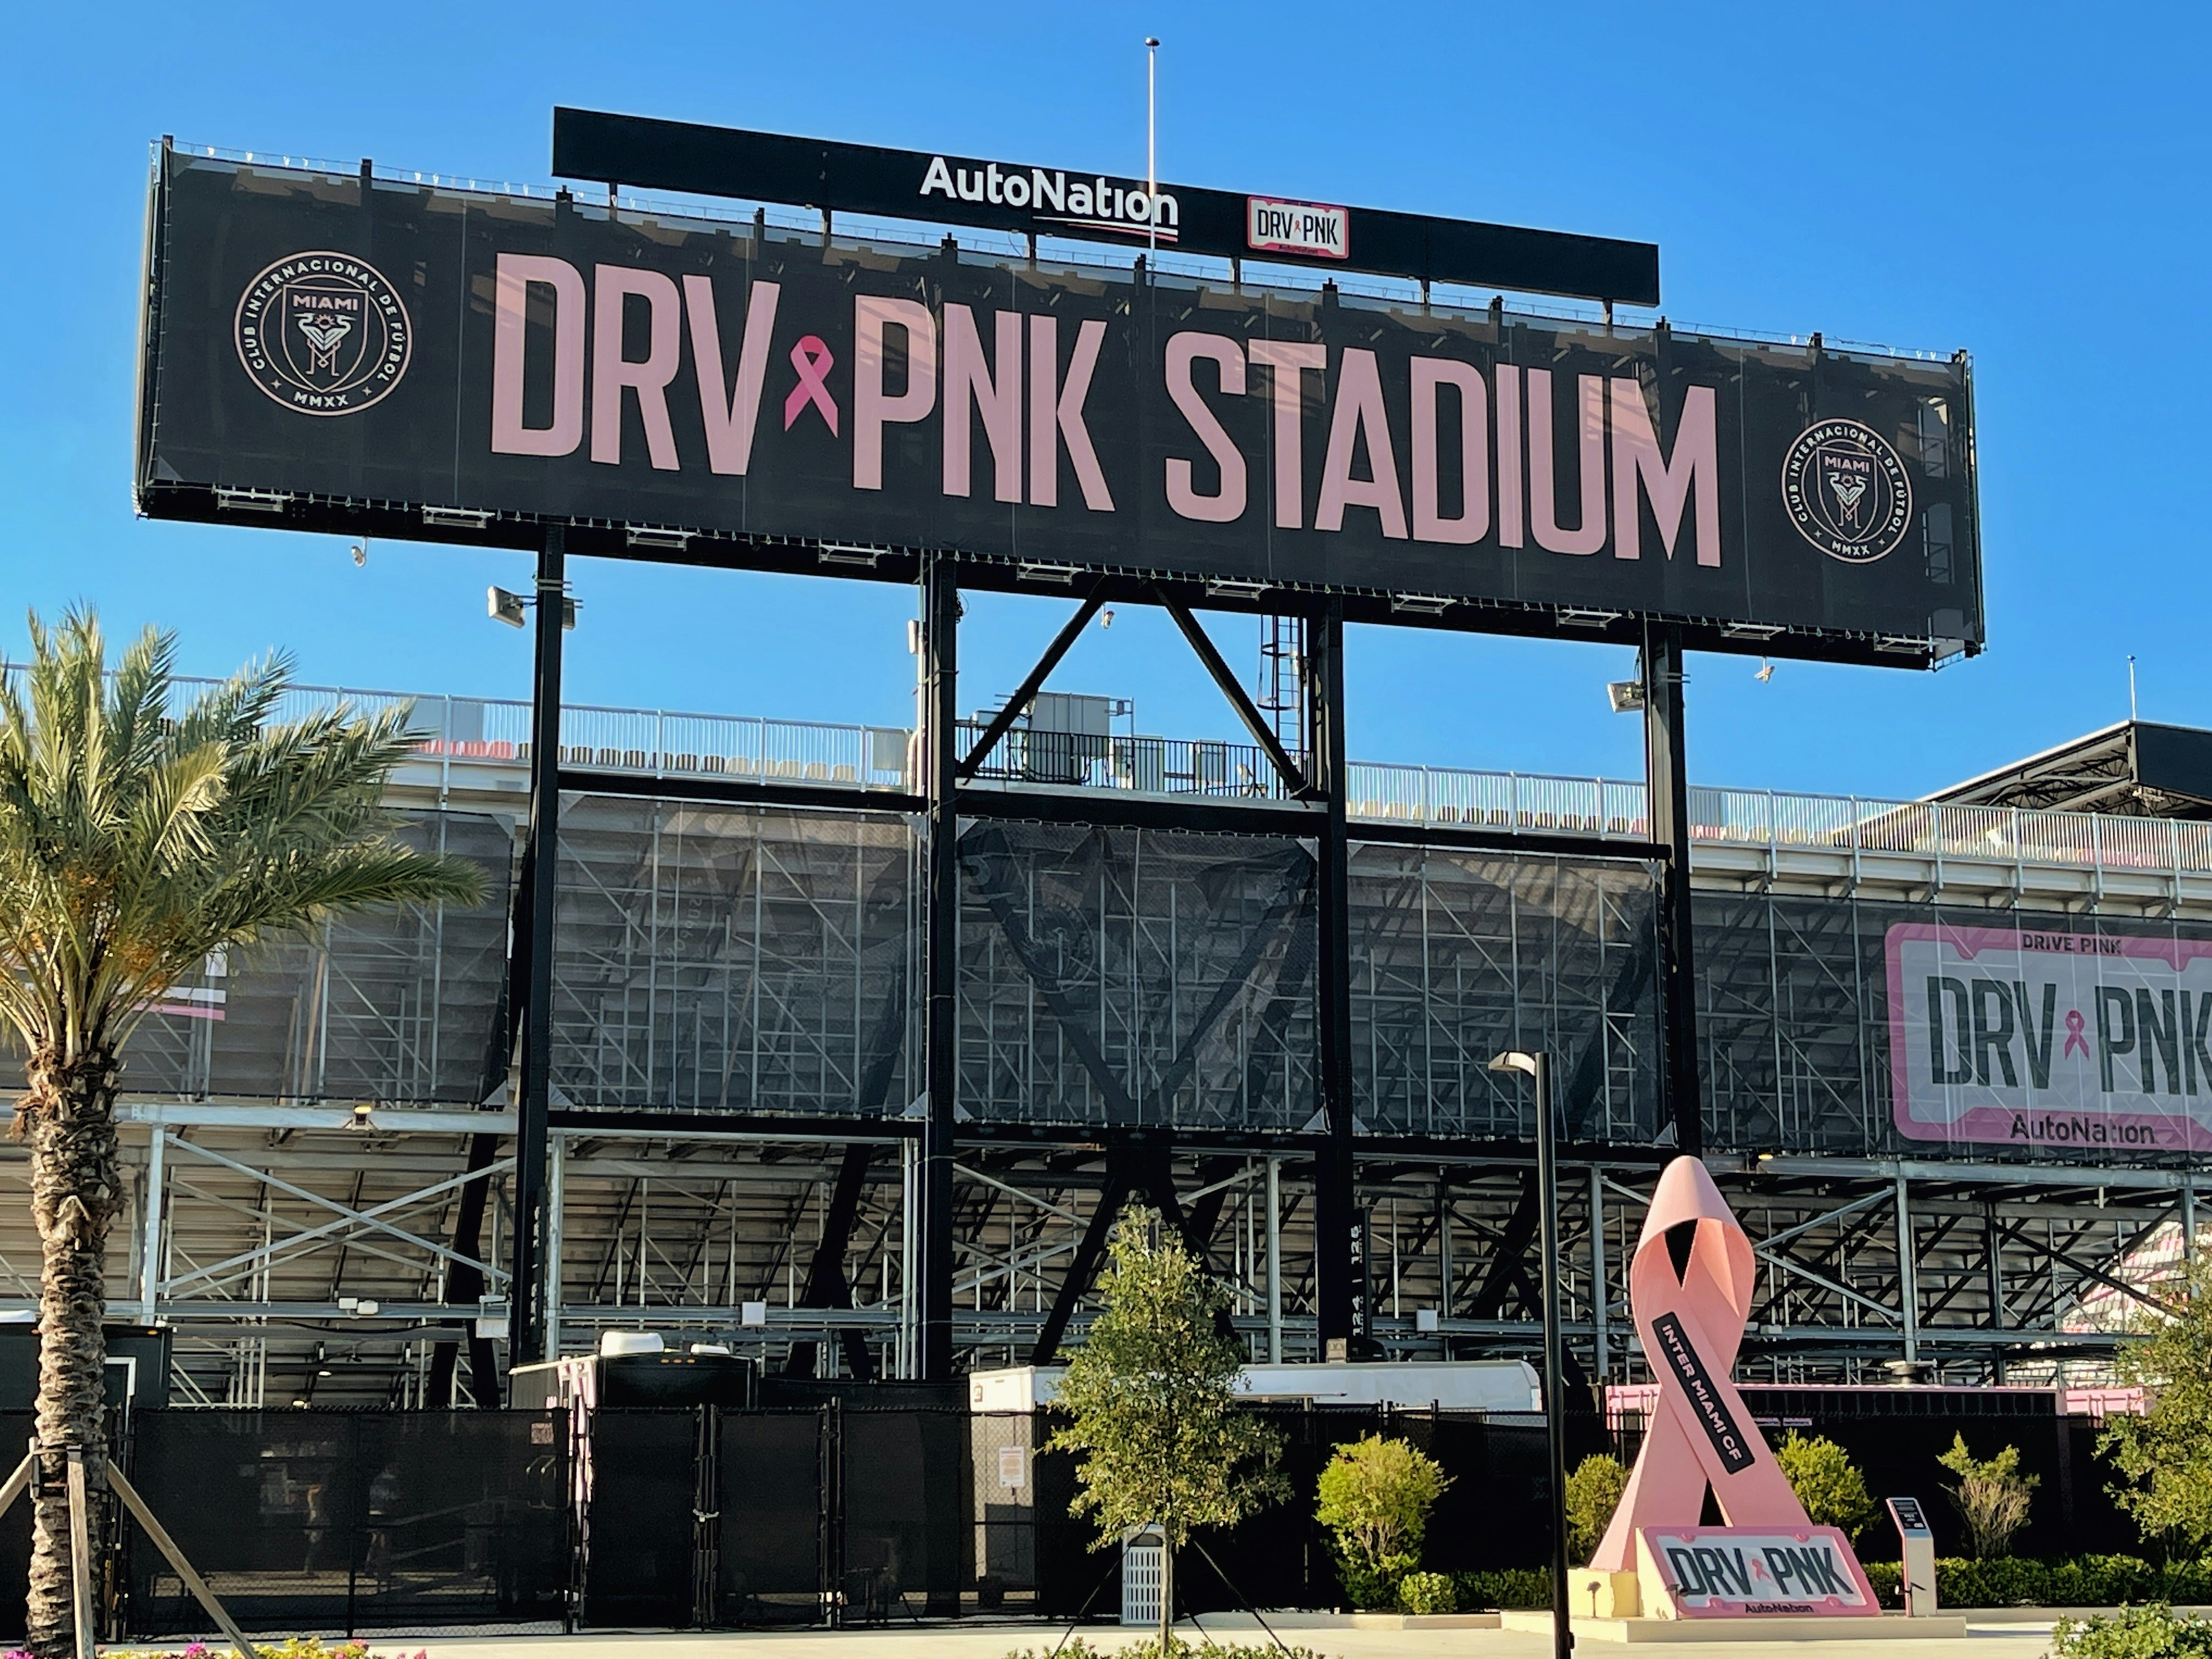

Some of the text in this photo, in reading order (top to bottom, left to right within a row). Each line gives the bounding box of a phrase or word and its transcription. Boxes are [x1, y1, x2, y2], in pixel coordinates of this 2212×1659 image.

[920, 156, 1179, 225] AutoNation
[1257, 209, 1338, 245] DRV PNK
[245, 259, 379, 318] INTERNACIONAL
[293, 295, 358, 311] MIAMI
[379, 294, 398, 316] DE
[244, 326, 266, 370] CLUB
[294, 391, 349, 407] MMXX
[491, 252, 1721, 568] DRV PNK STADIUM
[1790, 426, 1883, 478] INTERNACIONAL
[1824, 456, 1870, 473] MIAMI
[1884, 457, 1899, 475] DE
[1788, 484, 1808, 522] CLUB
[1831, 540, 1870, 556] MMXX
[2023, 934, 2121, 955] DRIVE PINK
[1927, 975, 2212, 1096] DRV PNK
[2010, 1114, 2155, 1144] AutoNation
[1662, 1324, 1742, 1461] INTER MIAMI CF
[1667, 1547, 1854, 1596] DRV PNK
[1745, 1603, 1814, 1613] AutoNation
